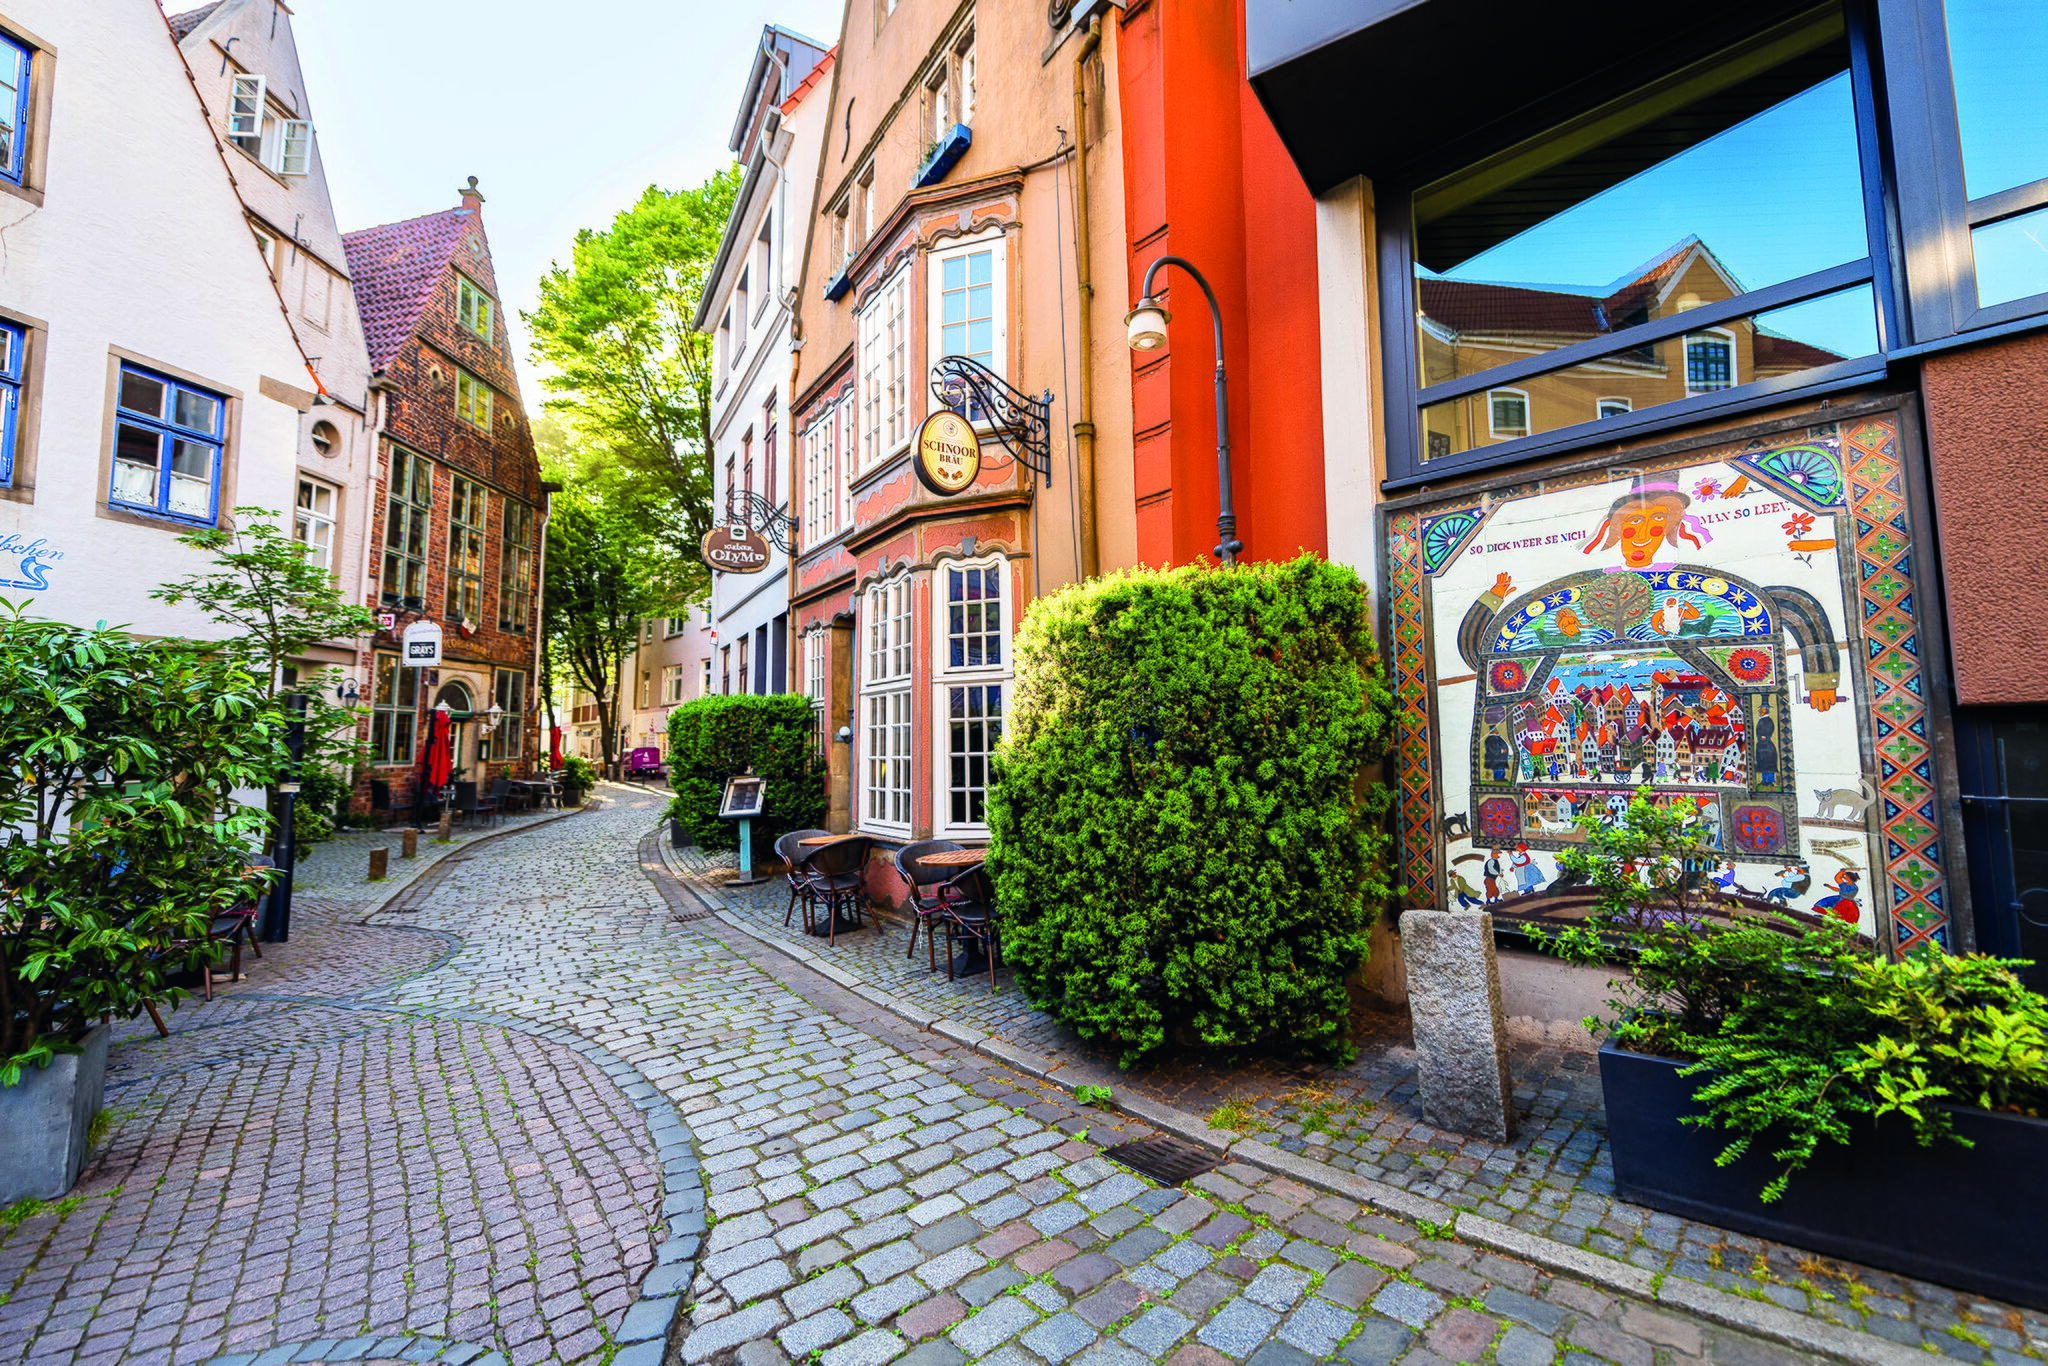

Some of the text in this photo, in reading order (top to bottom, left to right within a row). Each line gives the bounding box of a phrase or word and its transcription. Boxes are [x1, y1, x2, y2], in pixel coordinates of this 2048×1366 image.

[923, 439, 977, 459] SCHNOOR
[1733, 508, 1750, 520] SO
[0, 533, 65, 561] bchen
[1470, 530, 1587, 556] SO DICK WEER SE NICH
